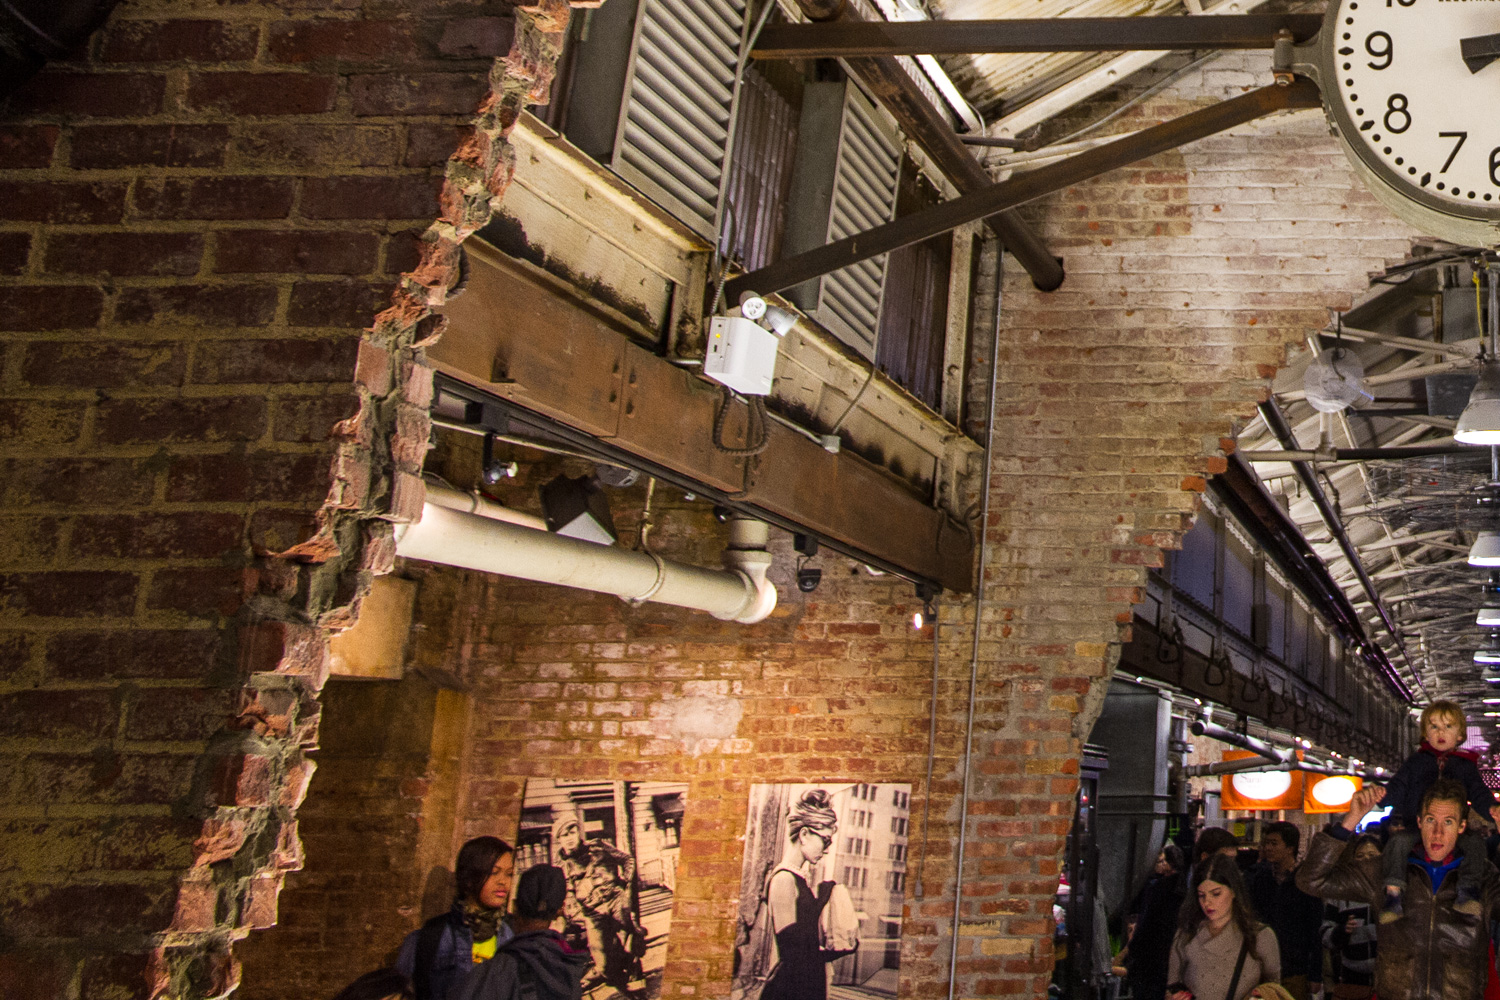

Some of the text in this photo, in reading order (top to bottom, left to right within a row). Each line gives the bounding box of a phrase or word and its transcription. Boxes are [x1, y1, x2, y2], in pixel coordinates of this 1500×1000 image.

[1364, 30, 1393, 70] 9
[1383, 93, 1412, 134] 8
[1438, 131, 1468, 173] 7
